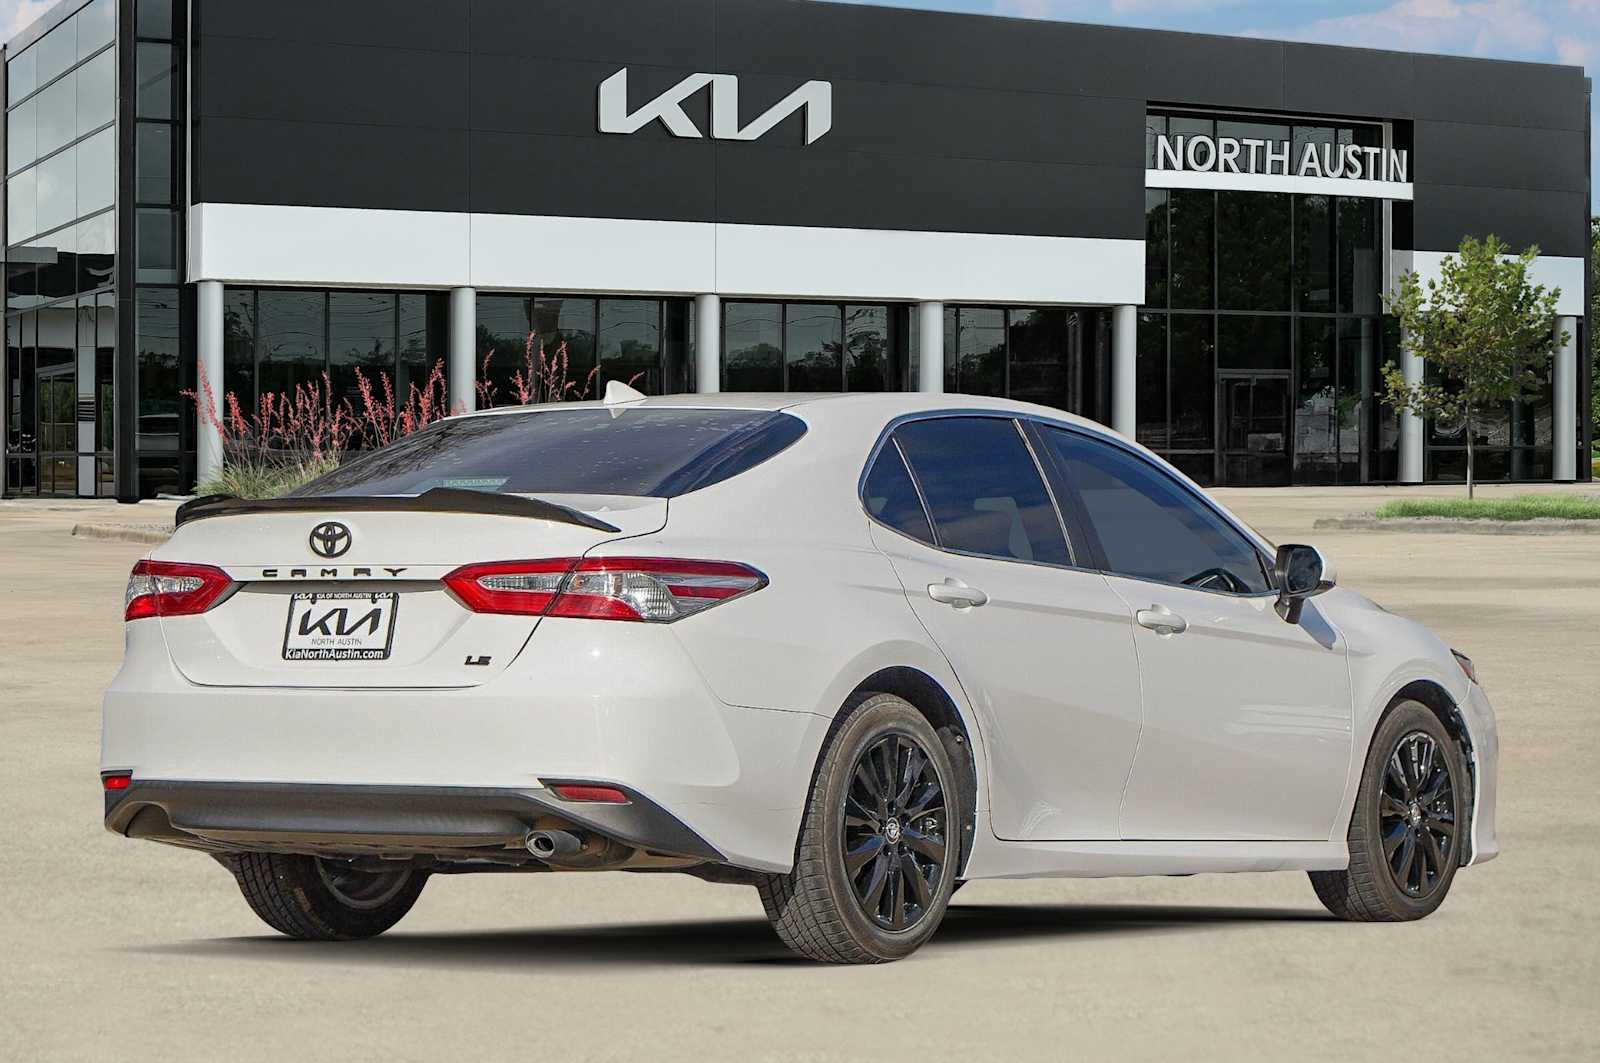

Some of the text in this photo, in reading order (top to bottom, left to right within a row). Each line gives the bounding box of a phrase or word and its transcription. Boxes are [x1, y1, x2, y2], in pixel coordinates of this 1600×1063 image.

[599, 67, 832, 145] KIA
[1156, 134, 1408, 182] NORTH AUSTIN
[262, 567, 408, 578] CAMRY
[298, 608, 382, 636] KIA
[311, 638, 362, 646] NORTH AUSTIN
[285, 649, 384, 659] KiaNorthAustin.com
[465, 655, 492, 666] LE
